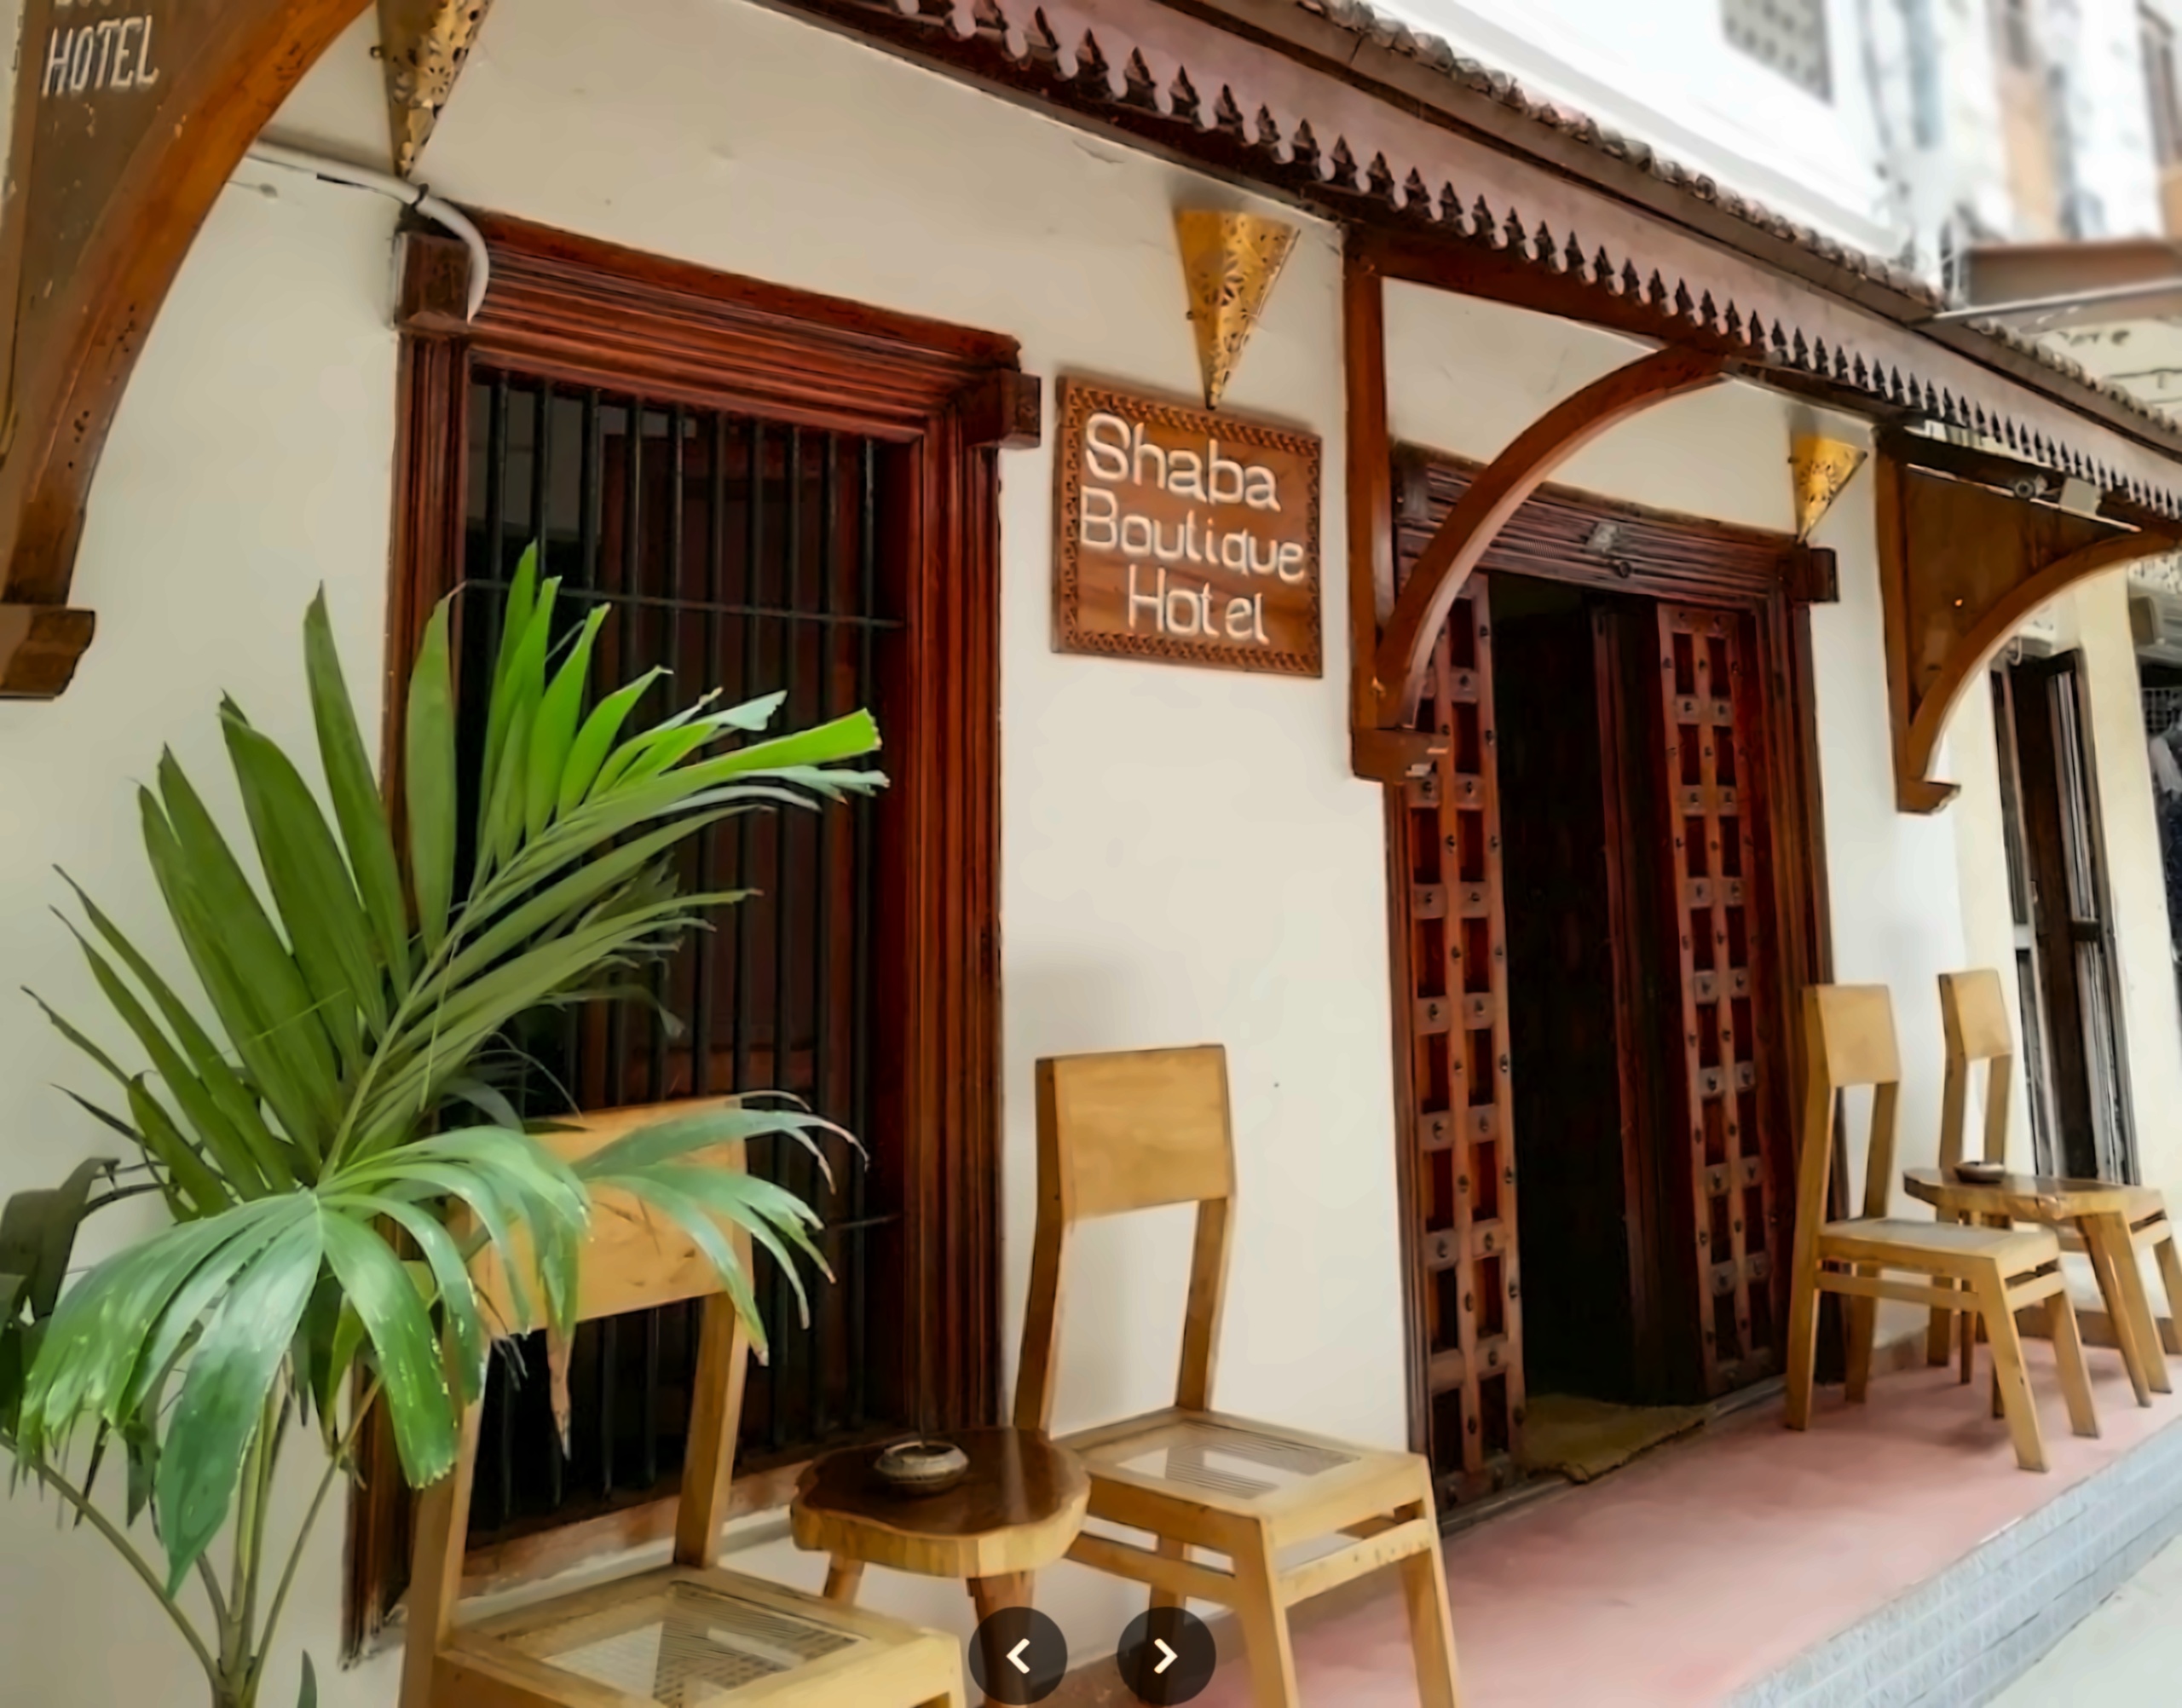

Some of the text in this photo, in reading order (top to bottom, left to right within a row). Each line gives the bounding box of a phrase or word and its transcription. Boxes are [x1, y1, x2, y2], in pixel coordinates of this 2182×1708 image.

[42, 14, 160, 98] HOTEL
[1086, 413, 1281, 512] Shaba
[1080, 485, 1305, 584] Boutique
[1128, 563, 1270, 645] Hotel
